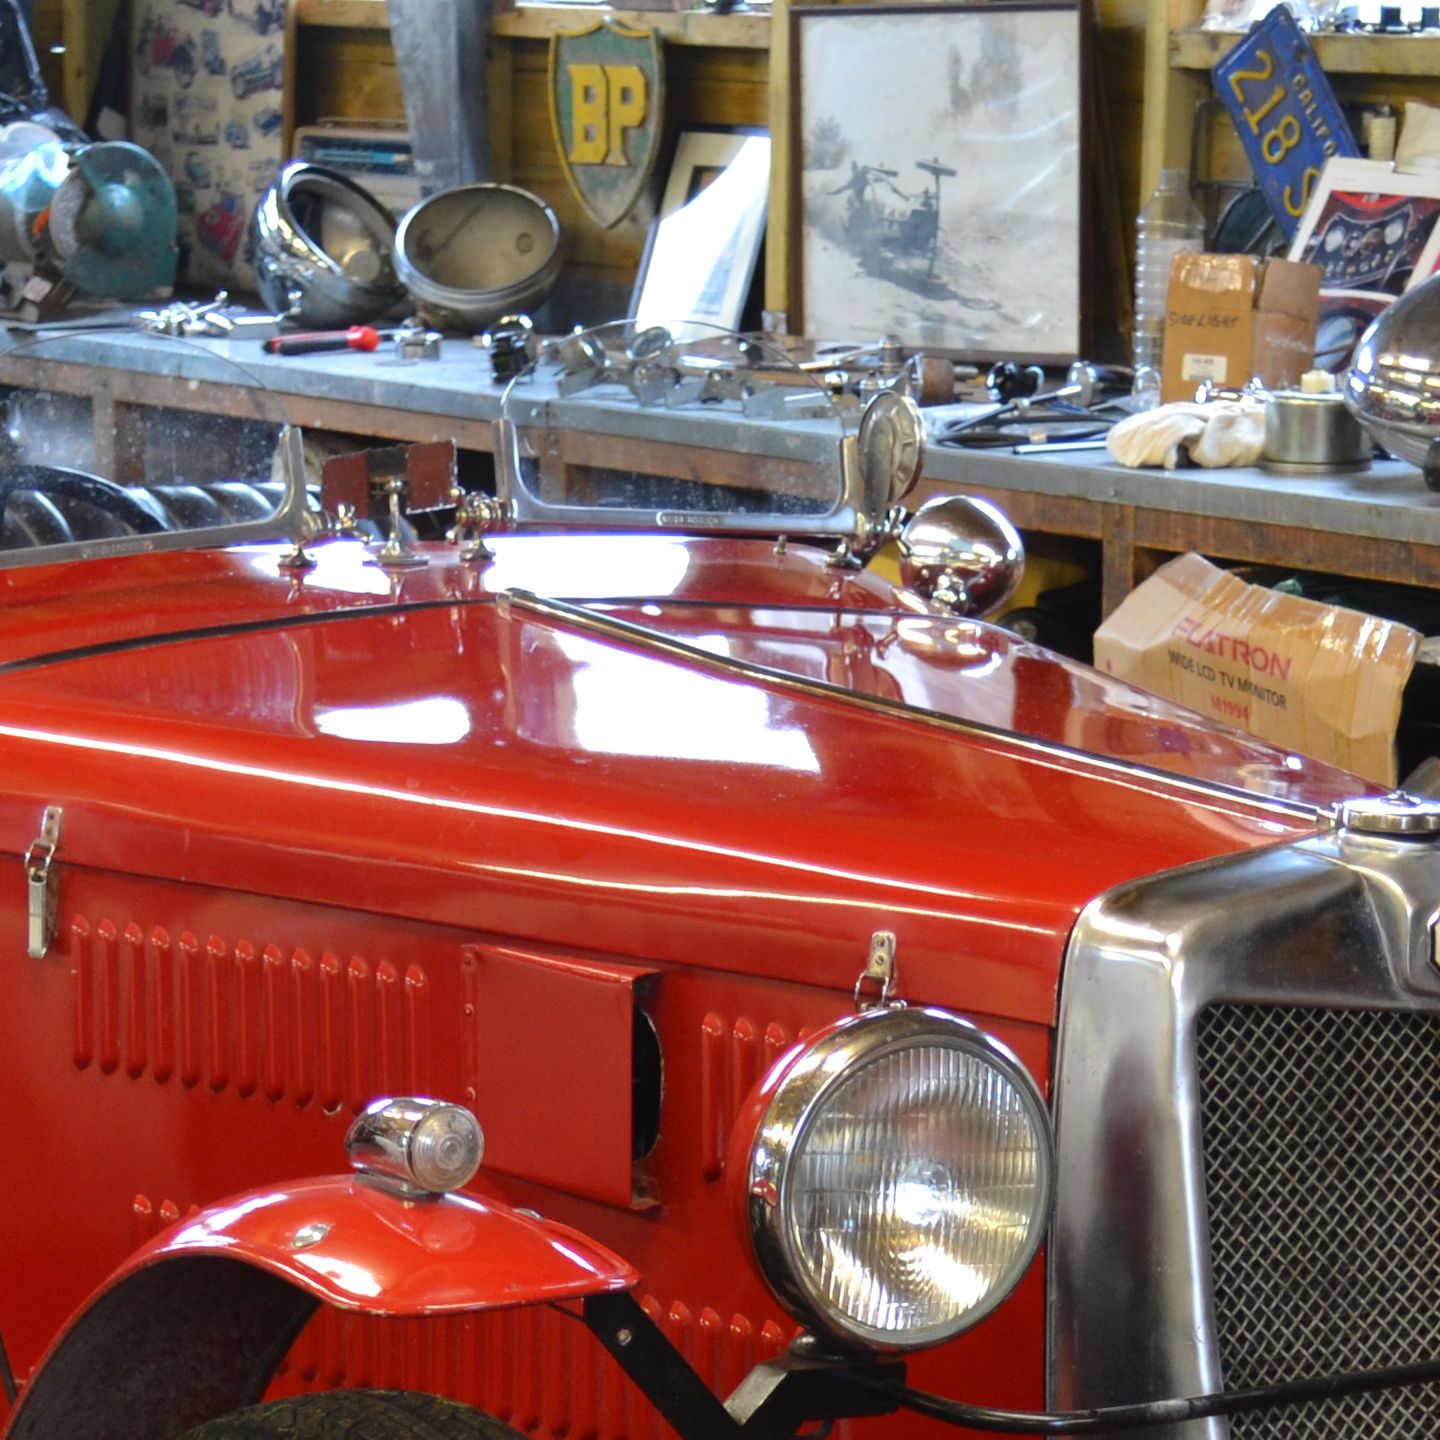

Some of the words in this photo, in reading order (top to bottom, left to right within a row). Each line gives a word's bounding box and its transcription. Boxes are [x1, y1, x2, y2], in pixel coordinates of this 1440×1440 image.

[566, 63, 649, 166] BP
[1228, 48, 1301, 165] 218
[1168, 648, 1196, 674] WIDE
[1196, 662, 1216, 682] LCD
[1219, 670, 1237, 689] TV
[1173, 616, 1293, 681] FLATRON
